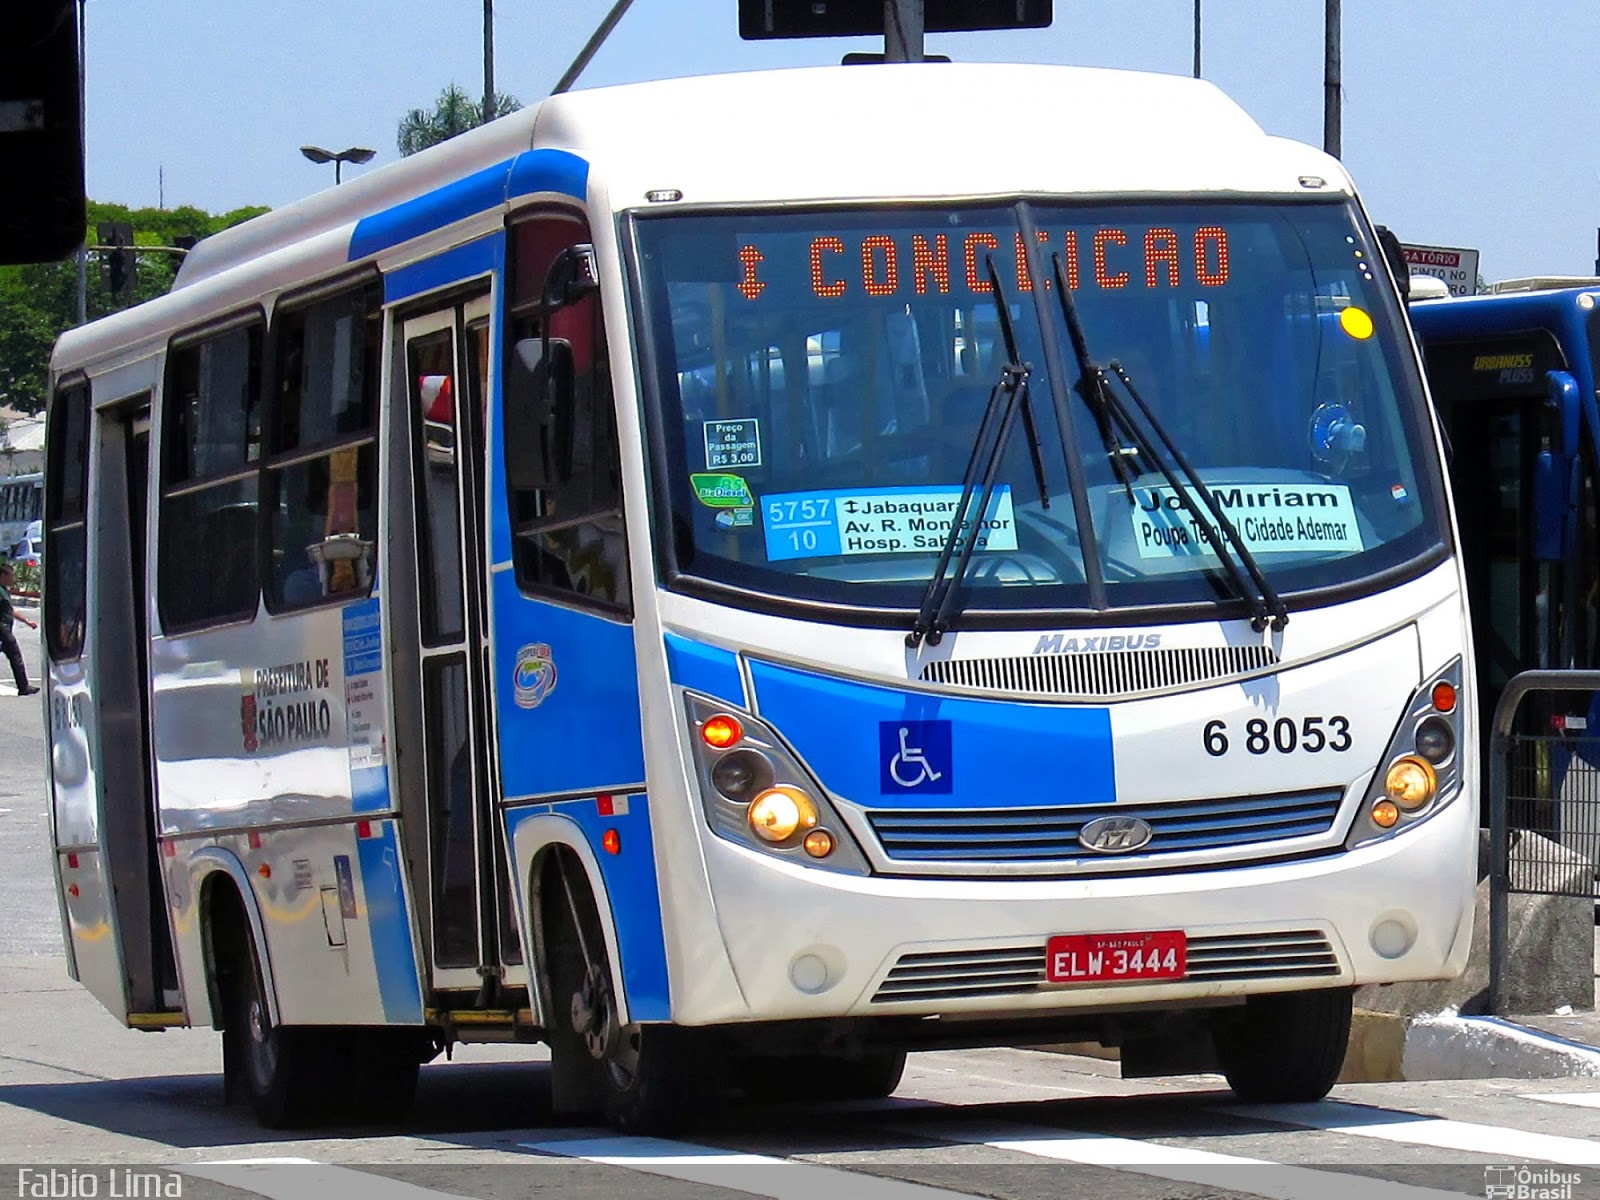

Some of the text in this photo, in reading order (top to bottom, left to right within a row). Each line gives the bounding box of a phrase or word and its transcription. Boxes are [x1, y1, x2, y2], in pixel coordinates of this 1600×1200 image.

[1450, 270, 1467, 280] NO
[715, 424, 743, 433] Preço
[724, 433, 737, 442] da
[708, 442, 756, 451] Passagem
[712, 454, 728, 464] R$
[1212, 488, 1339, 508] Miriam
[769, 499, 831, 523] 5757
[861, 500, 962, 516] Jabaquar
[844, 518, 1010, 534] Av. R. Moneor
[1141, 521, 1190, 551] Poupa
[1244, 517, 1294, 542] Cidade
[1297, 516, 1348, 541] Ademar
[788, 530, 817, 551] 10
[847, 535, 988, 551] Hosp. Saboa
[256, 660, 313, 699] PREFEITURA
[315, 658, 329, 689] DE
[259, 698, 331, 744] SÃO PAULO
[1203, 715, 1353, 757] 6 8053
